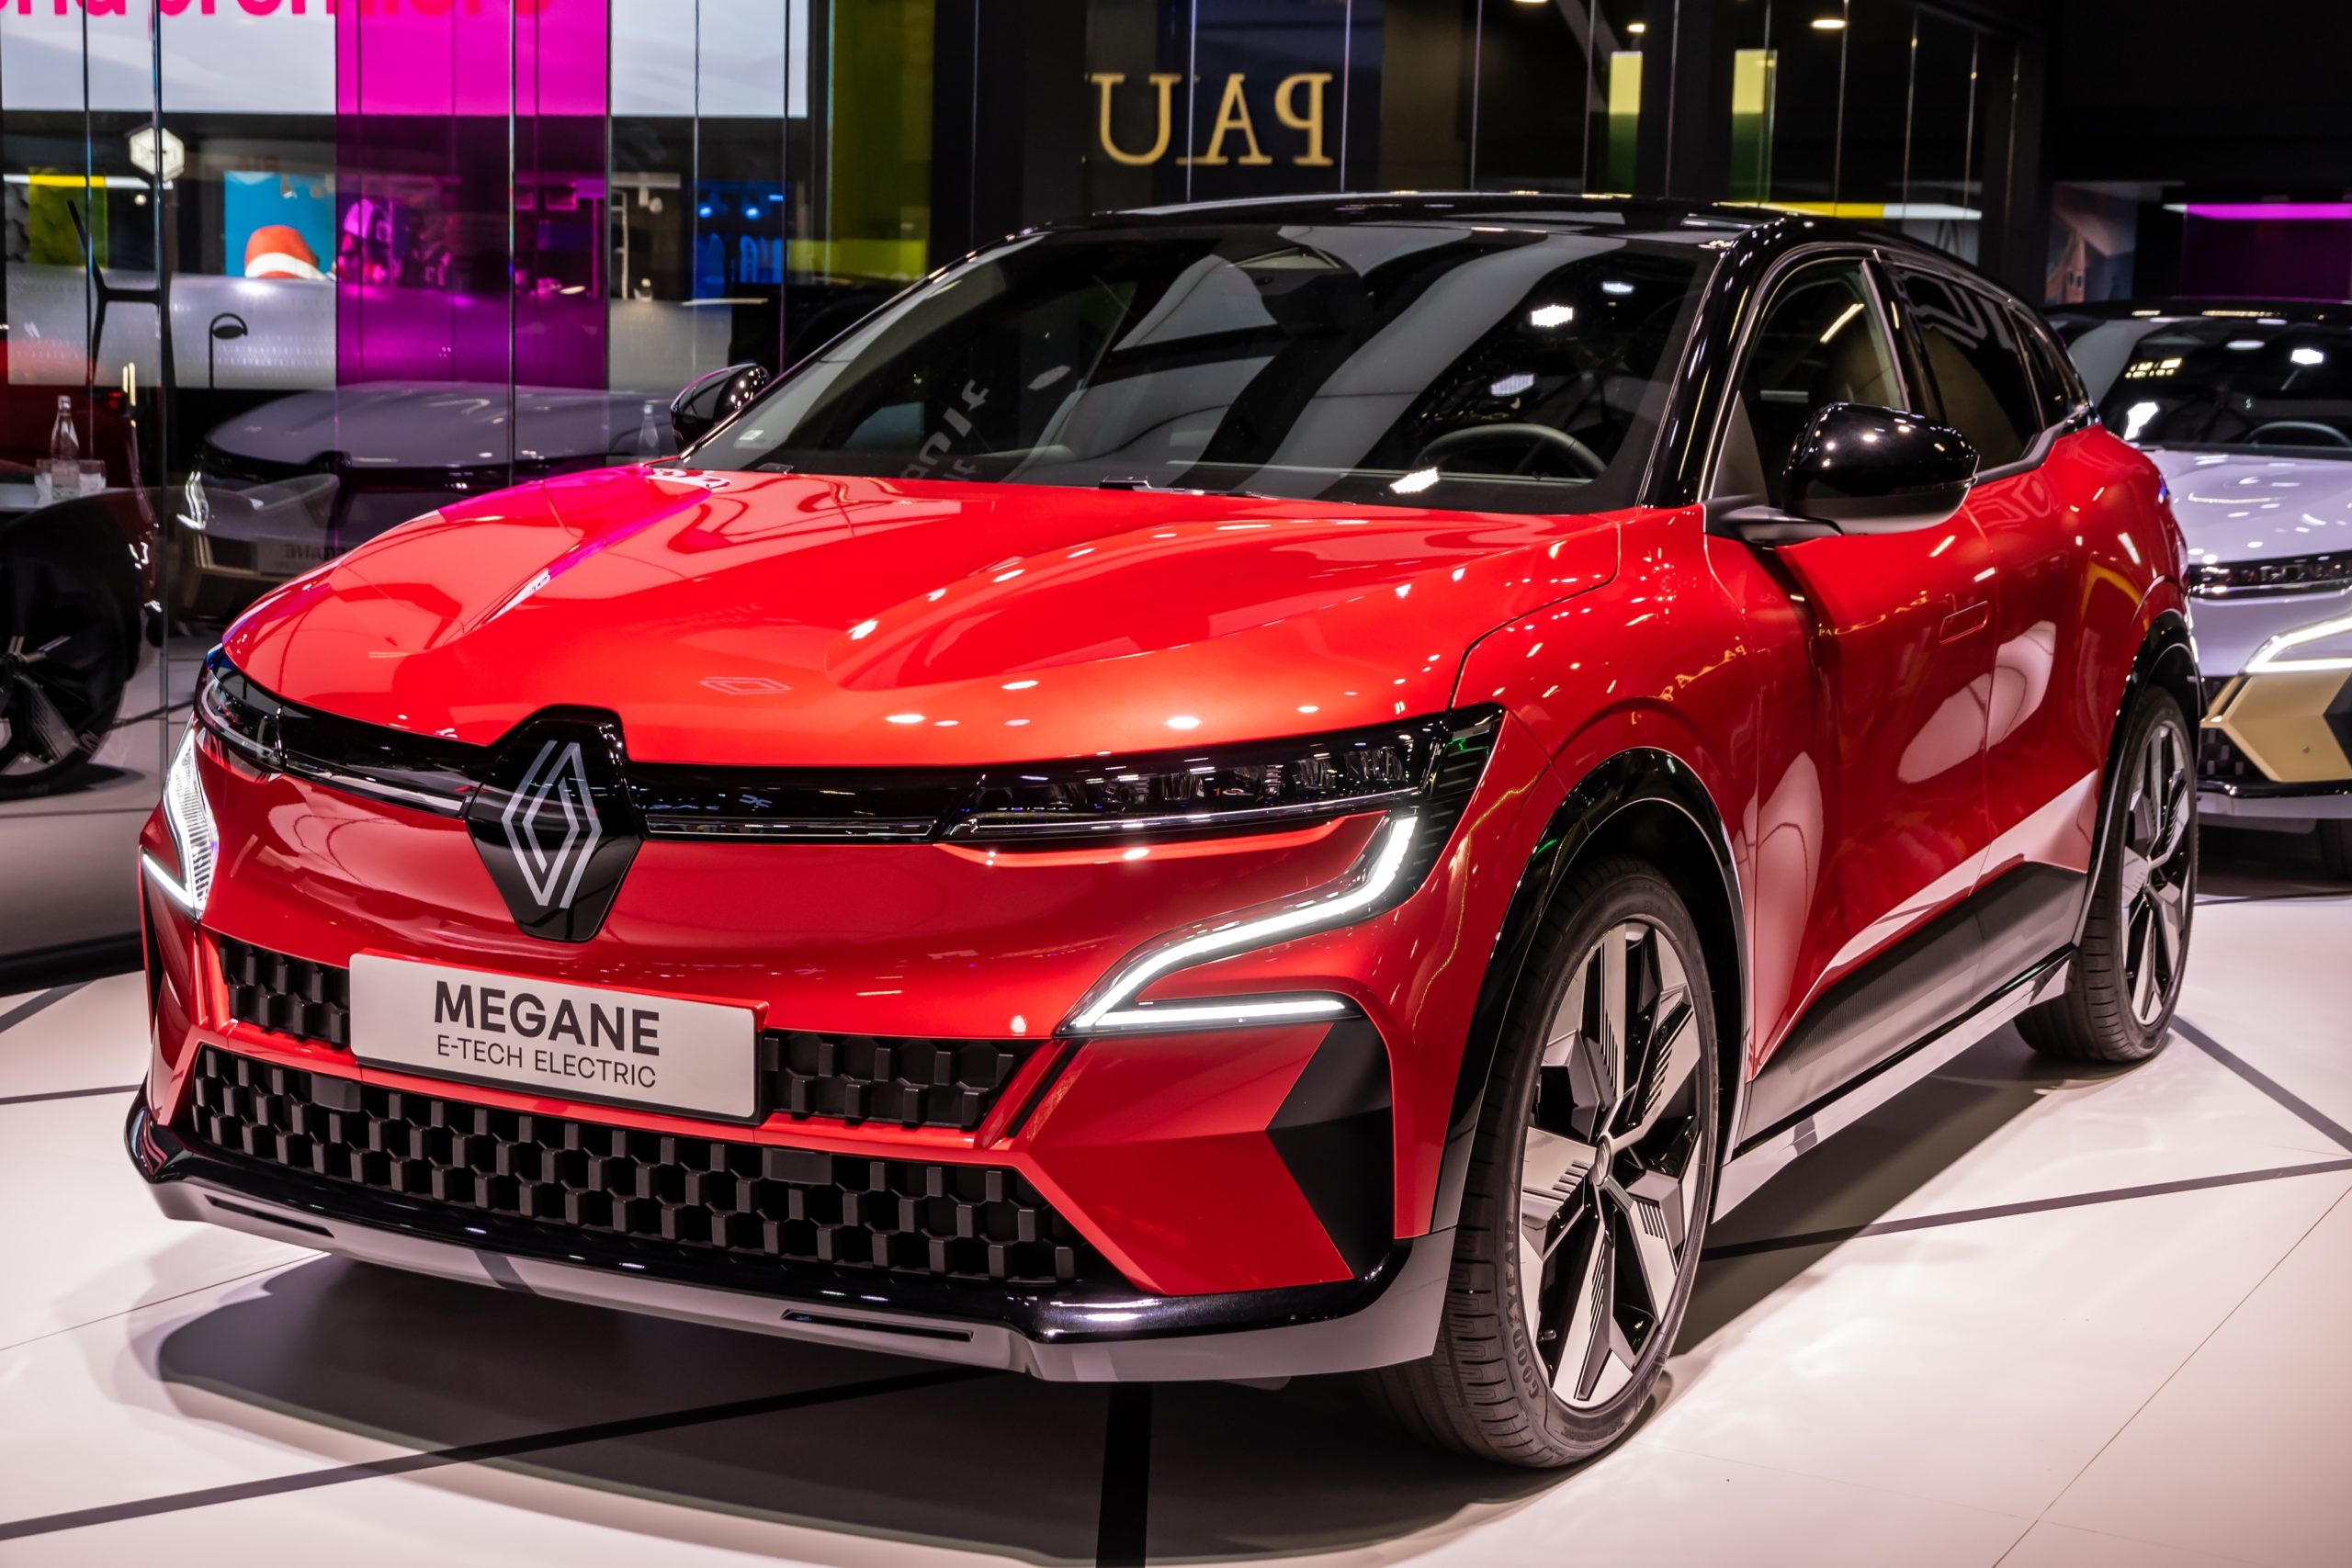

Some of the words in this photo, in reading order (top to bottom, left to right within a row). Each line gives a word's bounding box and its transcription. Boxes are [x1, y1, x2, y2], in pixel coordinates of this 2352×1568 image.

[435, 980, 660, 1056] MEGANE
[437, 1034, 523, 1068] E-TECH
[535, 1050, 657, 1089] ELECTRIC
